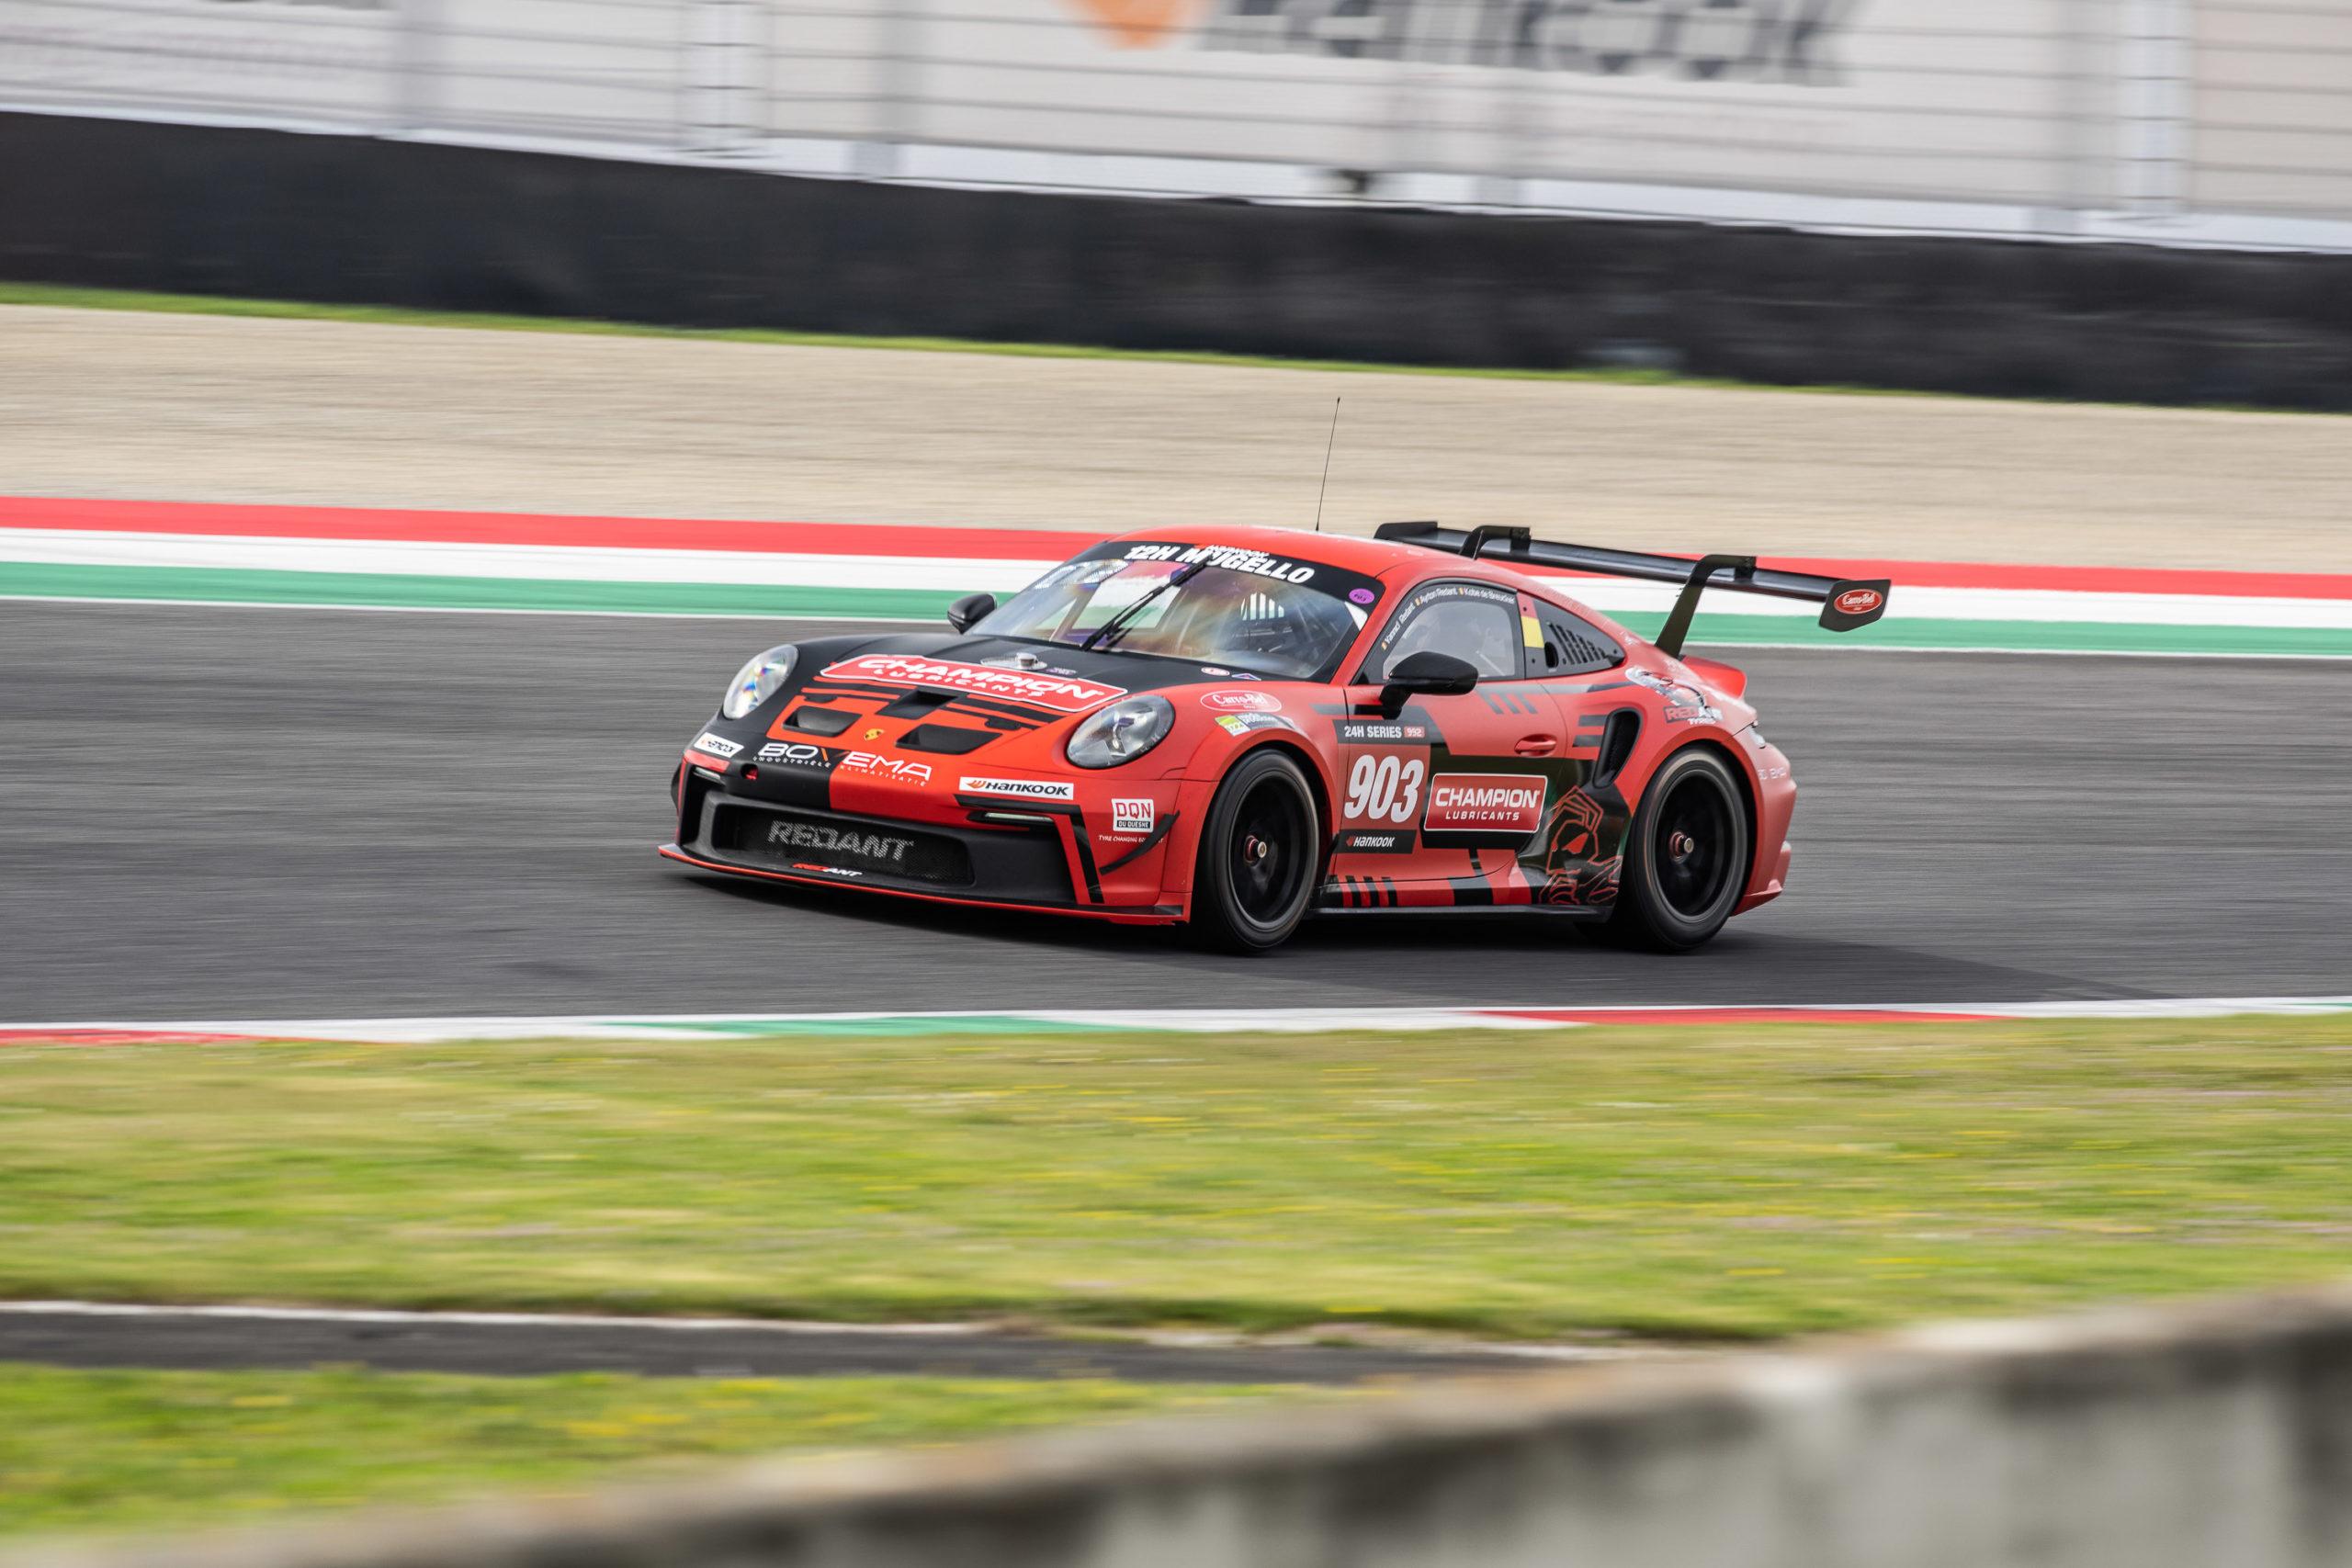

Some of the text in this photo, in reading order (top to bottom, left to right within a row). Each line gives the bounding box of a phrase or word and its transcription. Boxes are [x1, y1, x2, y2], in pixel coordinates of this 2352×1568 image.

[1124, 545, 1316, 583] 12H MUGELLO
[858, 659, 1099, 699] CHAMPION
[873, 668, 1046, 697] LUBRICANTS
[1344, 726, 1403, 739] 24H SERIES
[1407, 727, 1422, 737] 992
[1343, 754, 1424, 823] 903
[1435, 787, 1538, 808] CHAMPION
[1115, 802, 1151, 818] DQN
[1445, 810, 1520, 821] LUBRICANTS
[768, 820, 915, 861] REDANT
